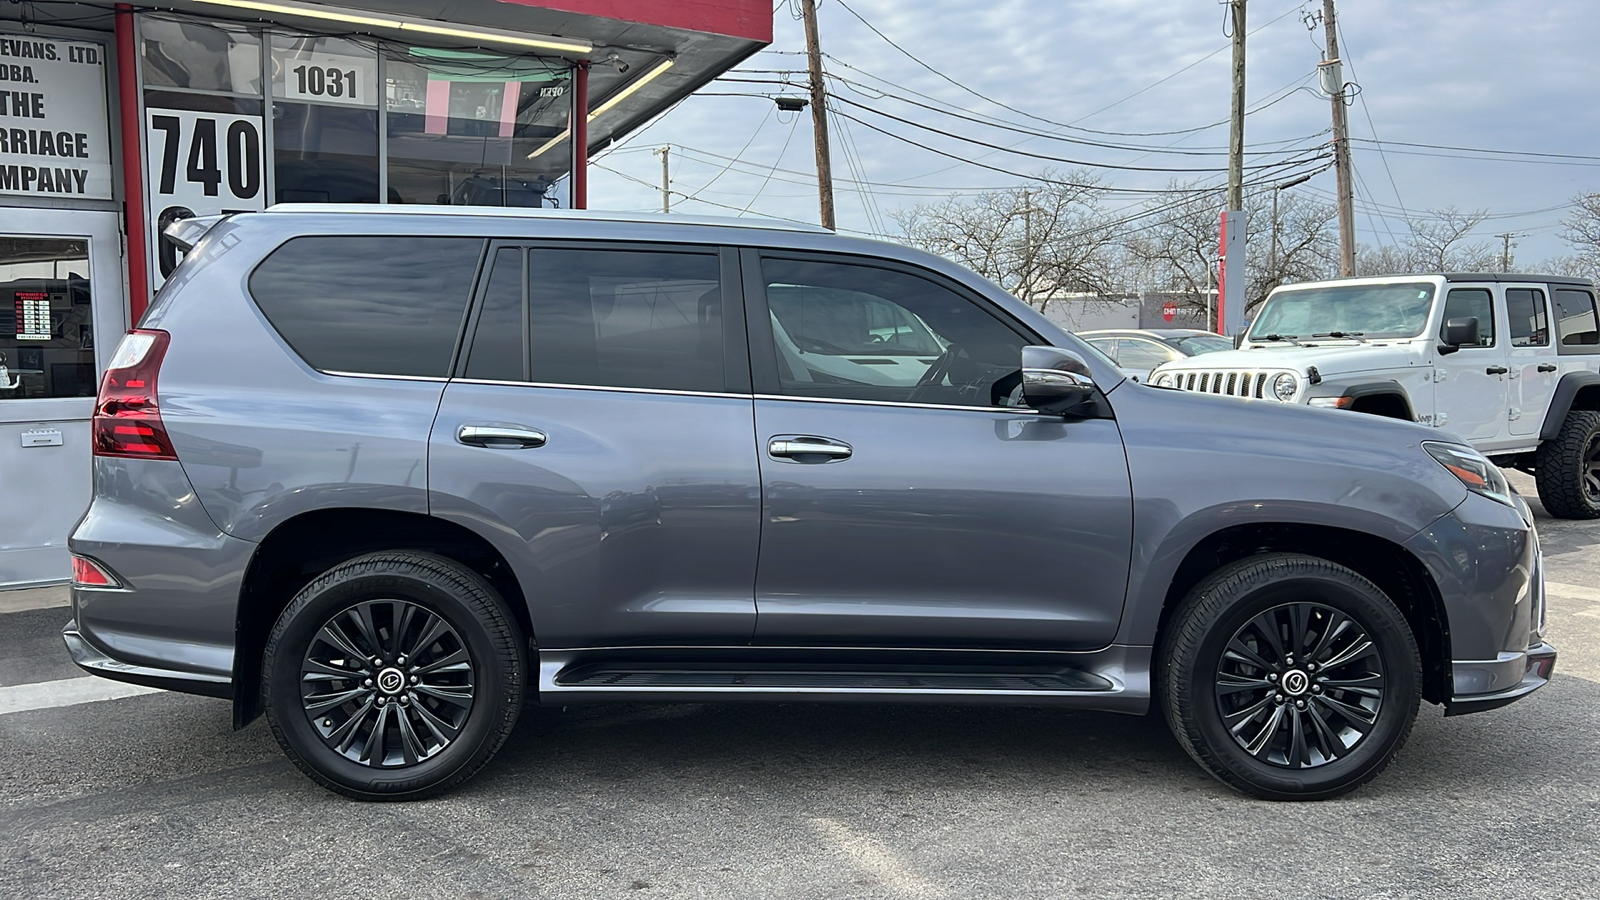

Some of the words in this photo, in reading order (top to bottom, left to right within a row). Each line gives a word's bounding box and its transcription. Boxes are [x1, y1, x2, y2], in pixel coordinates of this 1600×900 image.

[0, 38, 61, 61] EVANS.
[69, 46, 102, 65] LTD.
[0, 63, 39, 84] DBA.
[293, 65, 357, 99] 1031
[0, 91, 45, 119] THE
[152, 115, 261, 200] 740
